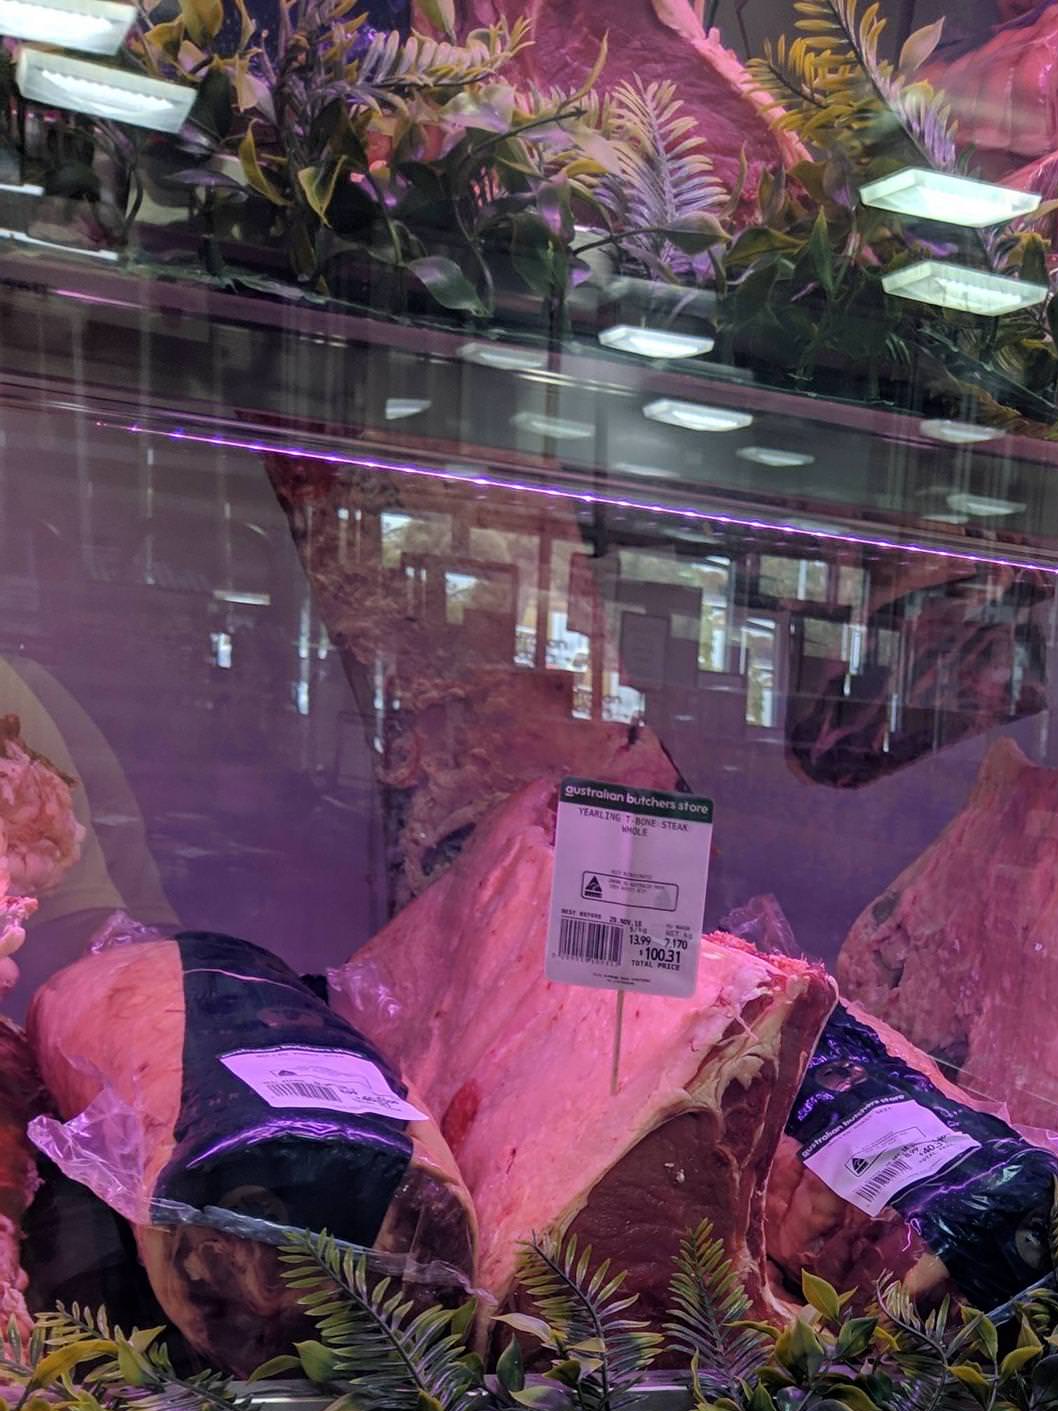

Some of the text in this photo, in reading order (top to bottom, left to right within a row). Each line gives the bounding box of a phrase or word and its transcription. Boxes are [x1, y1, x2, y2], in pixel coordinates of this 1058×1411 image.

[565, 784, 709, 814] australian butchers store
[579, 807, 621, 822] YEARLING
[662, 821, 688, 832] STEAK
[622, 826, 648, 837] WHOLE
[629, 934, 688, 949] 13.99 7.170
[632, 960, 681, 971] TOTAL PRICE
[801, 1124, 843, 1157] australian
